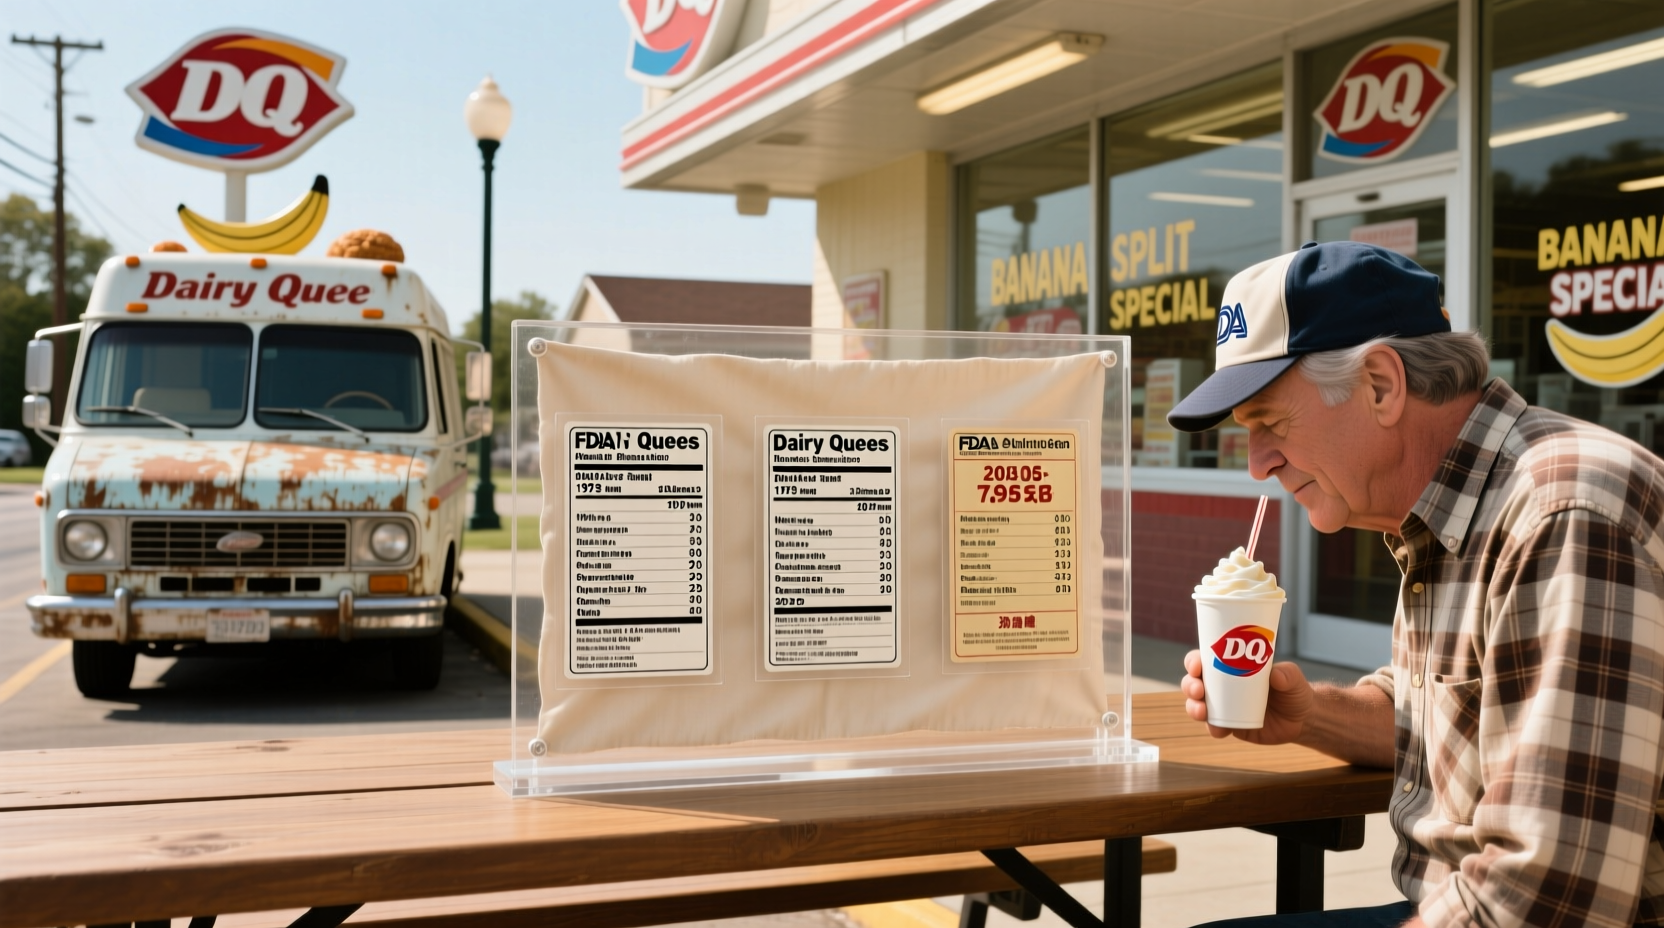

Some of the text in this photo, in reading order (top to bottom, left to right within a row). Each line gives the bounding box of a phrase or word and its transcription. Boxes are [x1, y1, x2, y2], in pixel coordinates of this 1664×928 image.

[170, 59, 309, 138] DQ
[1338, 62, 1423, 133] DQ
[991, 219, 1196, 307] BANANA SPLIT
[141, 271, 371, 308] Dairy Quee
[1109, 276, 1216, 331] SPECIAL
[637, 431, 700, 451] Quees
[773, 433, 889, 455] Dairy Quees
[1222, 636, 1270, 665] DQ
